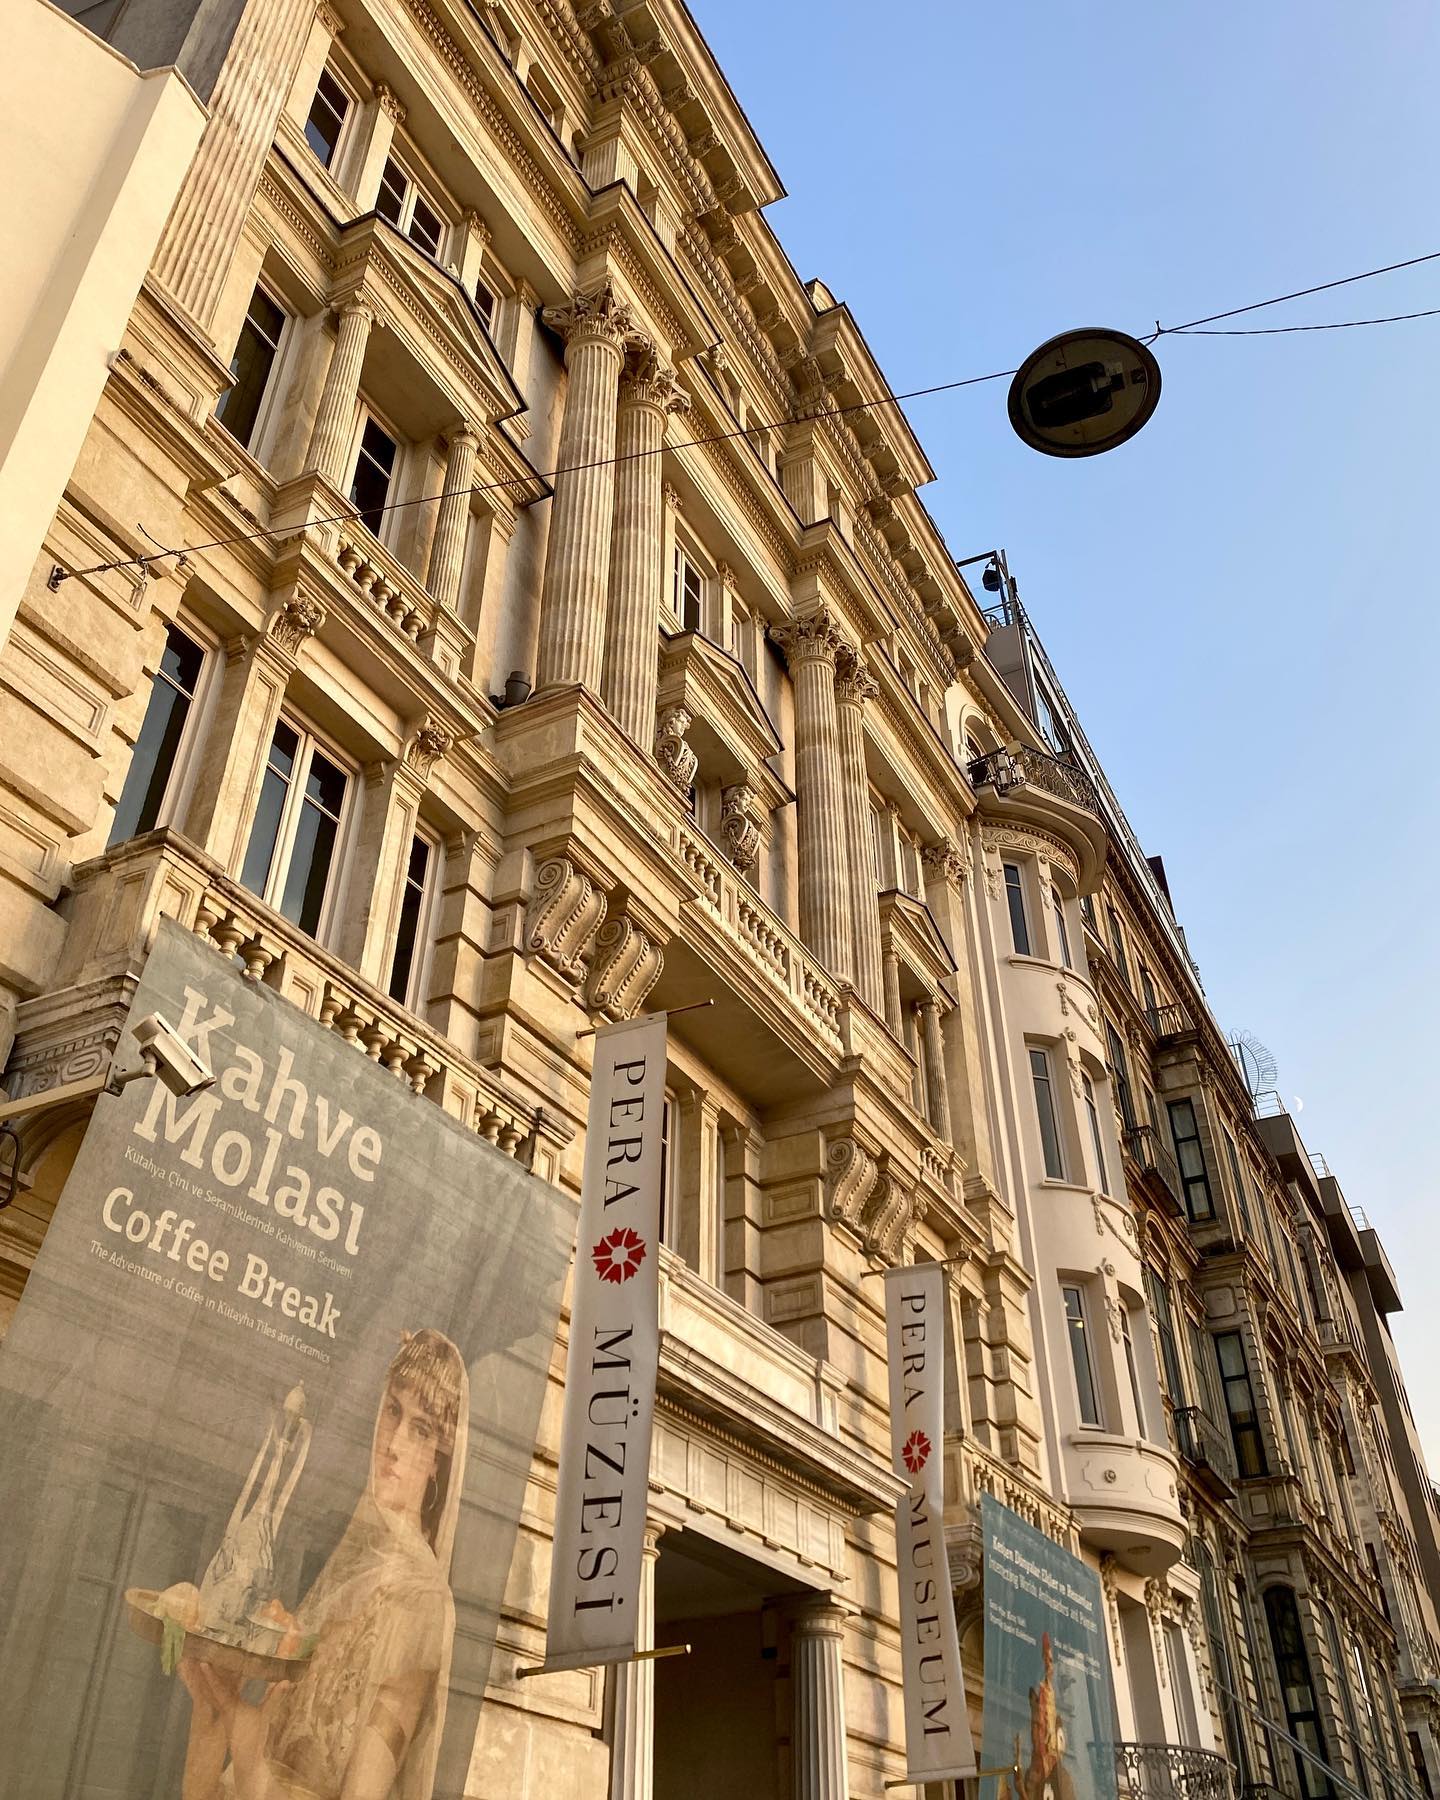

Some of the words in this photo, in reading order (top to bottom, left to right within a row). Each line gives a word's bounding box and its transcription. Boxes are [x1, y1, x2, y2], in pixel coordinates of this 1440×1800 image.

[177, 985, 382, 1182] Kahve
[603, 1055, 647, 1212] PERA
[132, 1077, 365, 1256] Molası
[191, 1183, 203, 1199] ve
[204, 1190, 275, 1236] Seramiklerinde
[275, 1227, 317, 1260] Kahvenin
[90, 1239, 108, 1260] The
[109, 1251, 163, 1285] Adventure
[163, 1278, 175, 1290] of
[175, 1281, 203, 1305] Coffee
[205, 1294, 217, 1311] in
[255, 1318, 277, 1338] Tiles
[277, 1330, 294, 1346] and
[294, 1338, 331, 1364] Ceramics
[102, 1186, 229, 1282] Coffee
[237, 1252, 341, 1339] Break
[901, 1290, 926, 1409] PERA
[574, 1323, 639, 1619] MÜZESİ
[909, 1492, 952, 1741] MUSEUM
